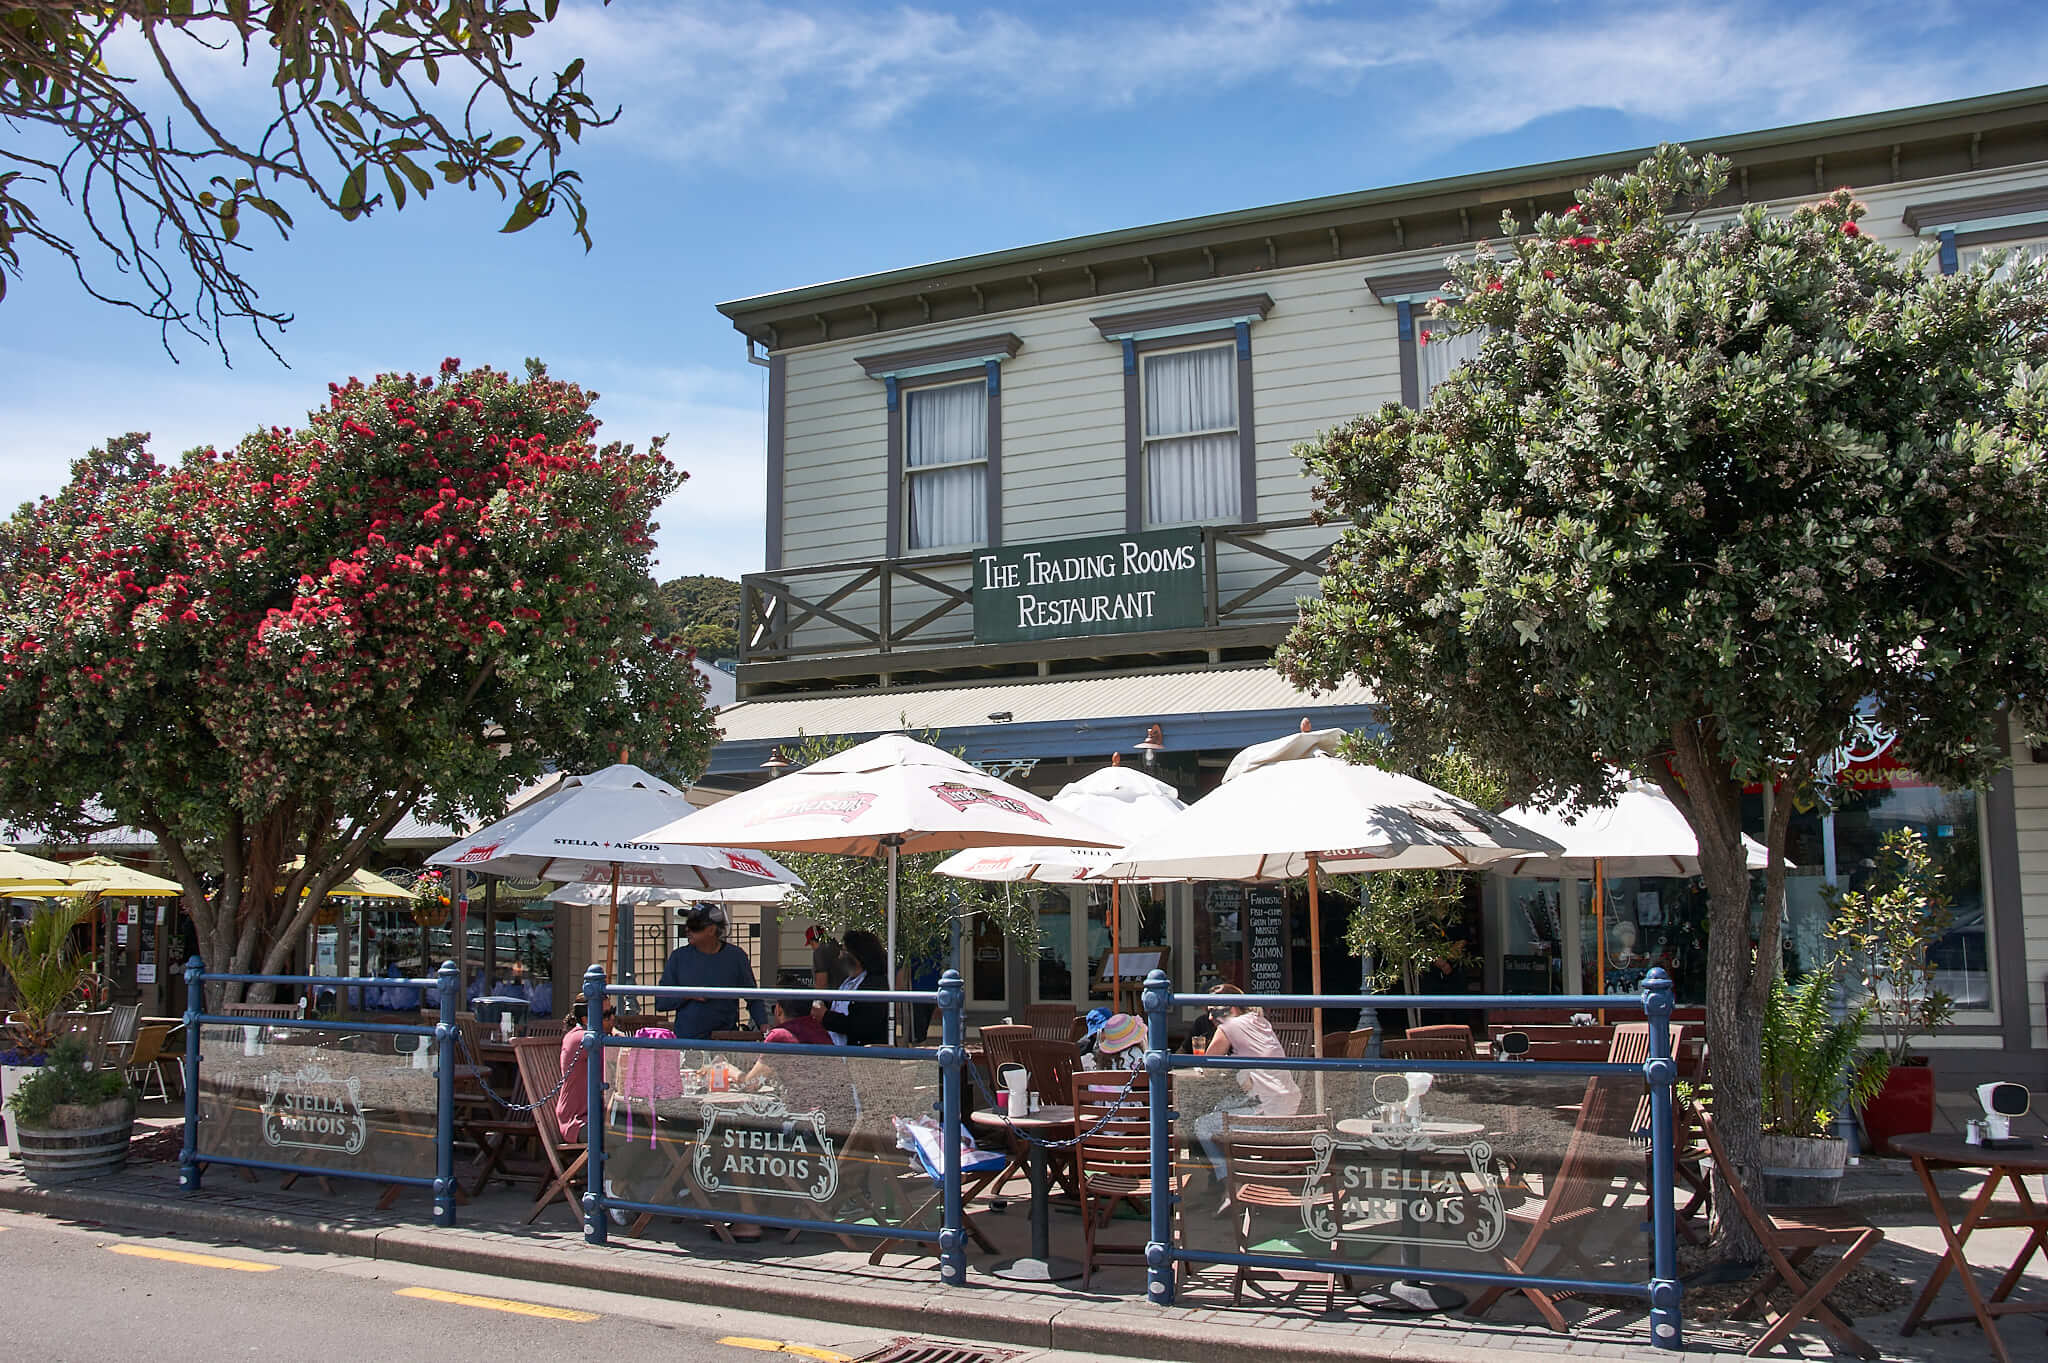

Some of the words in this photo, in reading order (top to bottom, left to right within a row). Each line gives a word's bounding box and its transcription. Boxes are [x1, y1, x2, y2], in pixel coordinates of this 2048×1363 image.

[1017, 591, 1156, 628] RESTAURANT
[554, 838, 599, 847] STELLA
[613, 841, 661, 851] ARTOIS
[1251, 947, 1284, 960] SALMON
[284, 1093, 345, 1113] STELLA
[282, 1115, 346, 1136] ARTOIS
[723, 1128, 808, 1153] STELLA
[722, 1154, 809, 1180] ARTOIS
[1343, 1165, 1464, 1194] STELLA
[1342, 1196, 1465, 1225] ARTOIS
